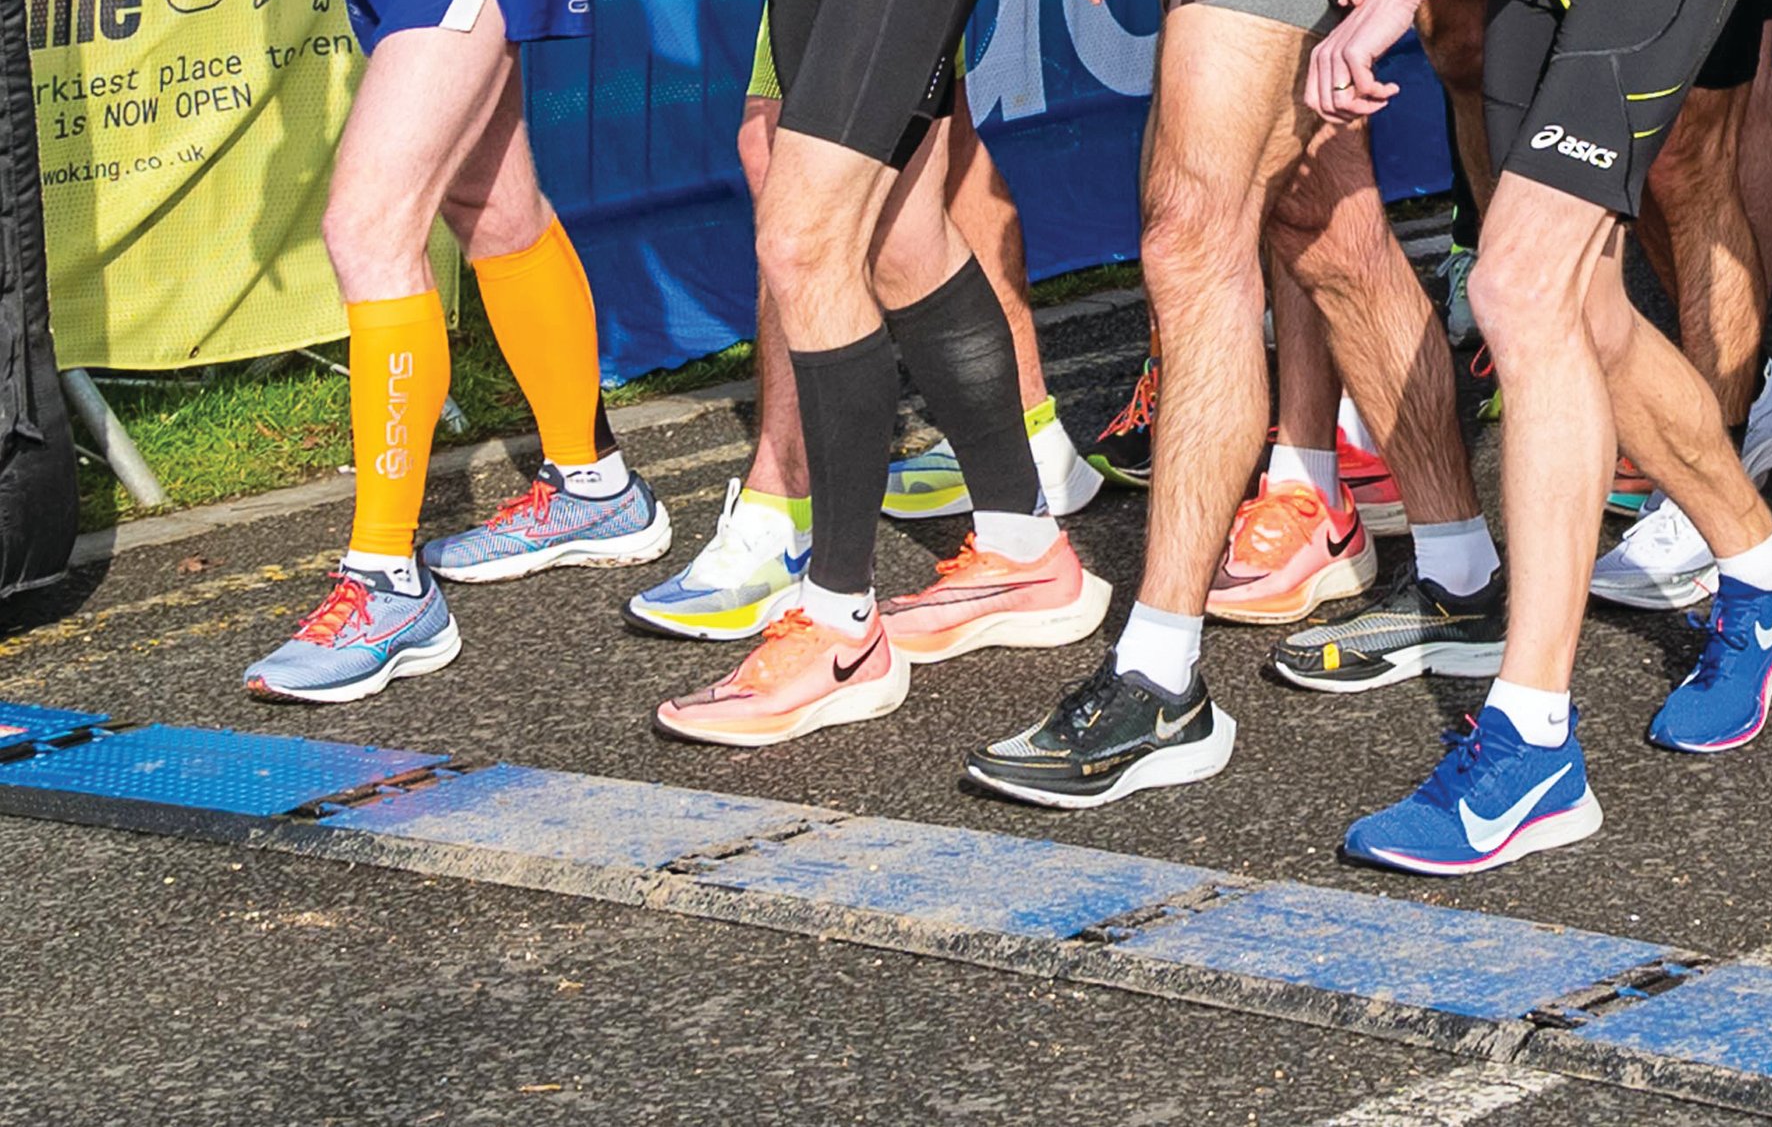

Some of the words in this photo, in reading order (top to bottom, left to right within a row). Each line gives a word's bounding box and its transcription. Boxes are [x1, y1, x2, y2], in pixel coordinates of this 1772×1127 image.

[159, 54, 243, 92] place
[54, 112, 87, 140] is
[103, 97, 160, 129] NOW
[175, 83, 252, 118] OPEN
